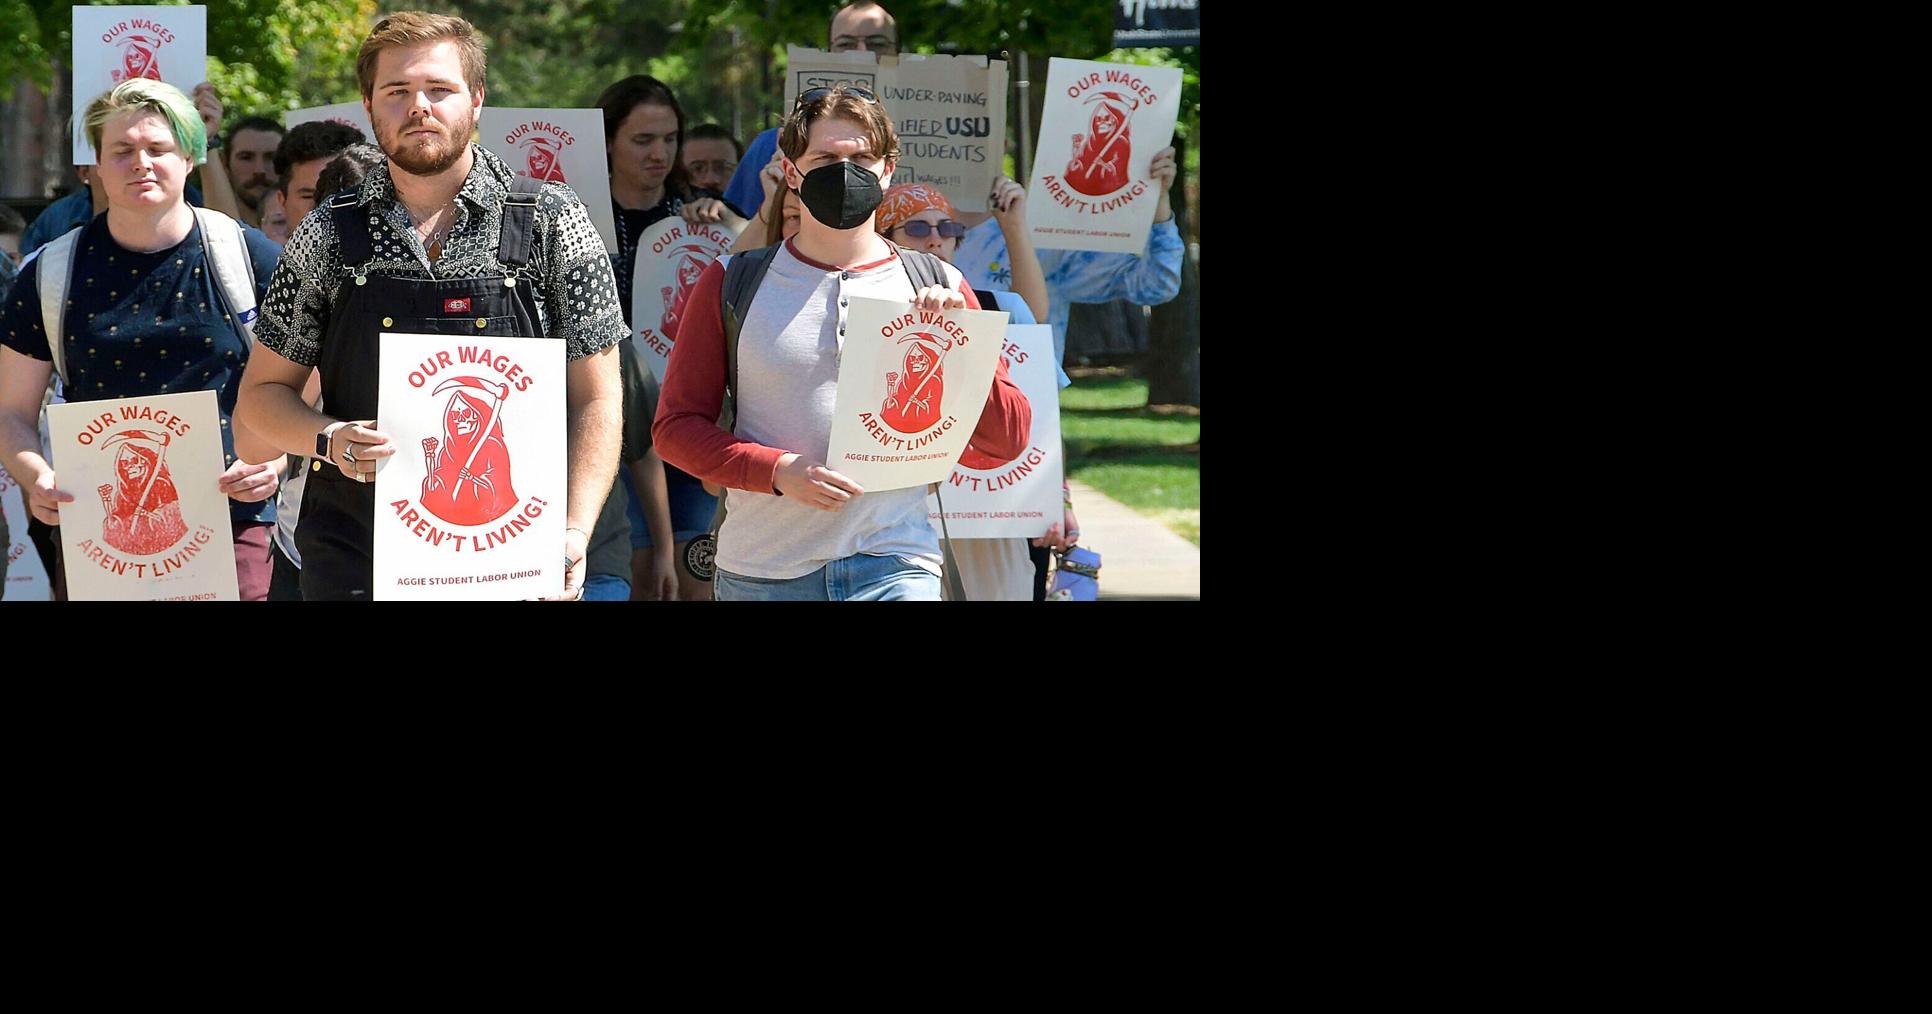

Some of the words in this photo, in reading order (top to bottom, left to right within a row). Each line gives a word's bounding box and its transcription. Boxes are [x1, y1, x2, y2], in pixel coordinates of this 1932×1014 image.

[102, 22, 128, 43] OUR
[131, 19, 175, 43] WAGES
[884, 86, 987, 106] UNDER-PAYING
[1068, 72, 1101, 98] OUR
[1105, 70, 1157, 105] WAGES
[505, 124, 530, 144] OUR
[531, 121, 575, 145] WAGES
[900, 119, 943, 135] IFIED
[946, 117, 990, 137] USU
[900, 142, 985, 162] TUDENTS
[1042, 175, 1088, 214] AREN'T
[1091, 180, 1148, 214] LIVING!
[652, 227, 682, 254] OUR
[640, 328, 671, 358] ARE
[881, 314, 915, 338] OUR
[919, 311, 969, 346] WAGES
[408, 350, 453, 388] OUR
[457, 346, 533, 392] WAGES
[78, 412, 117, 445] OUR
[120, 405, 190, 437] WAGES
[859, 412, 904, 451] AREN'T
[907, 415, 957, 451] LIVING!
[845, 453, 869, 461] AGGIE
[948, 471, 982, 492] N'T
[987, 447, 1047, 492] LIVING!
[390, 499, 467, 552] AREN'T
[472, 496, 548, 552] LIVING!
[77, 538, 146, 578] AREN'T
[152, 525, 215, 577] LIVING!
[397, 577, 427, 586] AGGIE
[429, 576, 474, 585] STUDENT
[476, 573, 508, 583] LABOR
[510, 569, 541, 580] UNION
